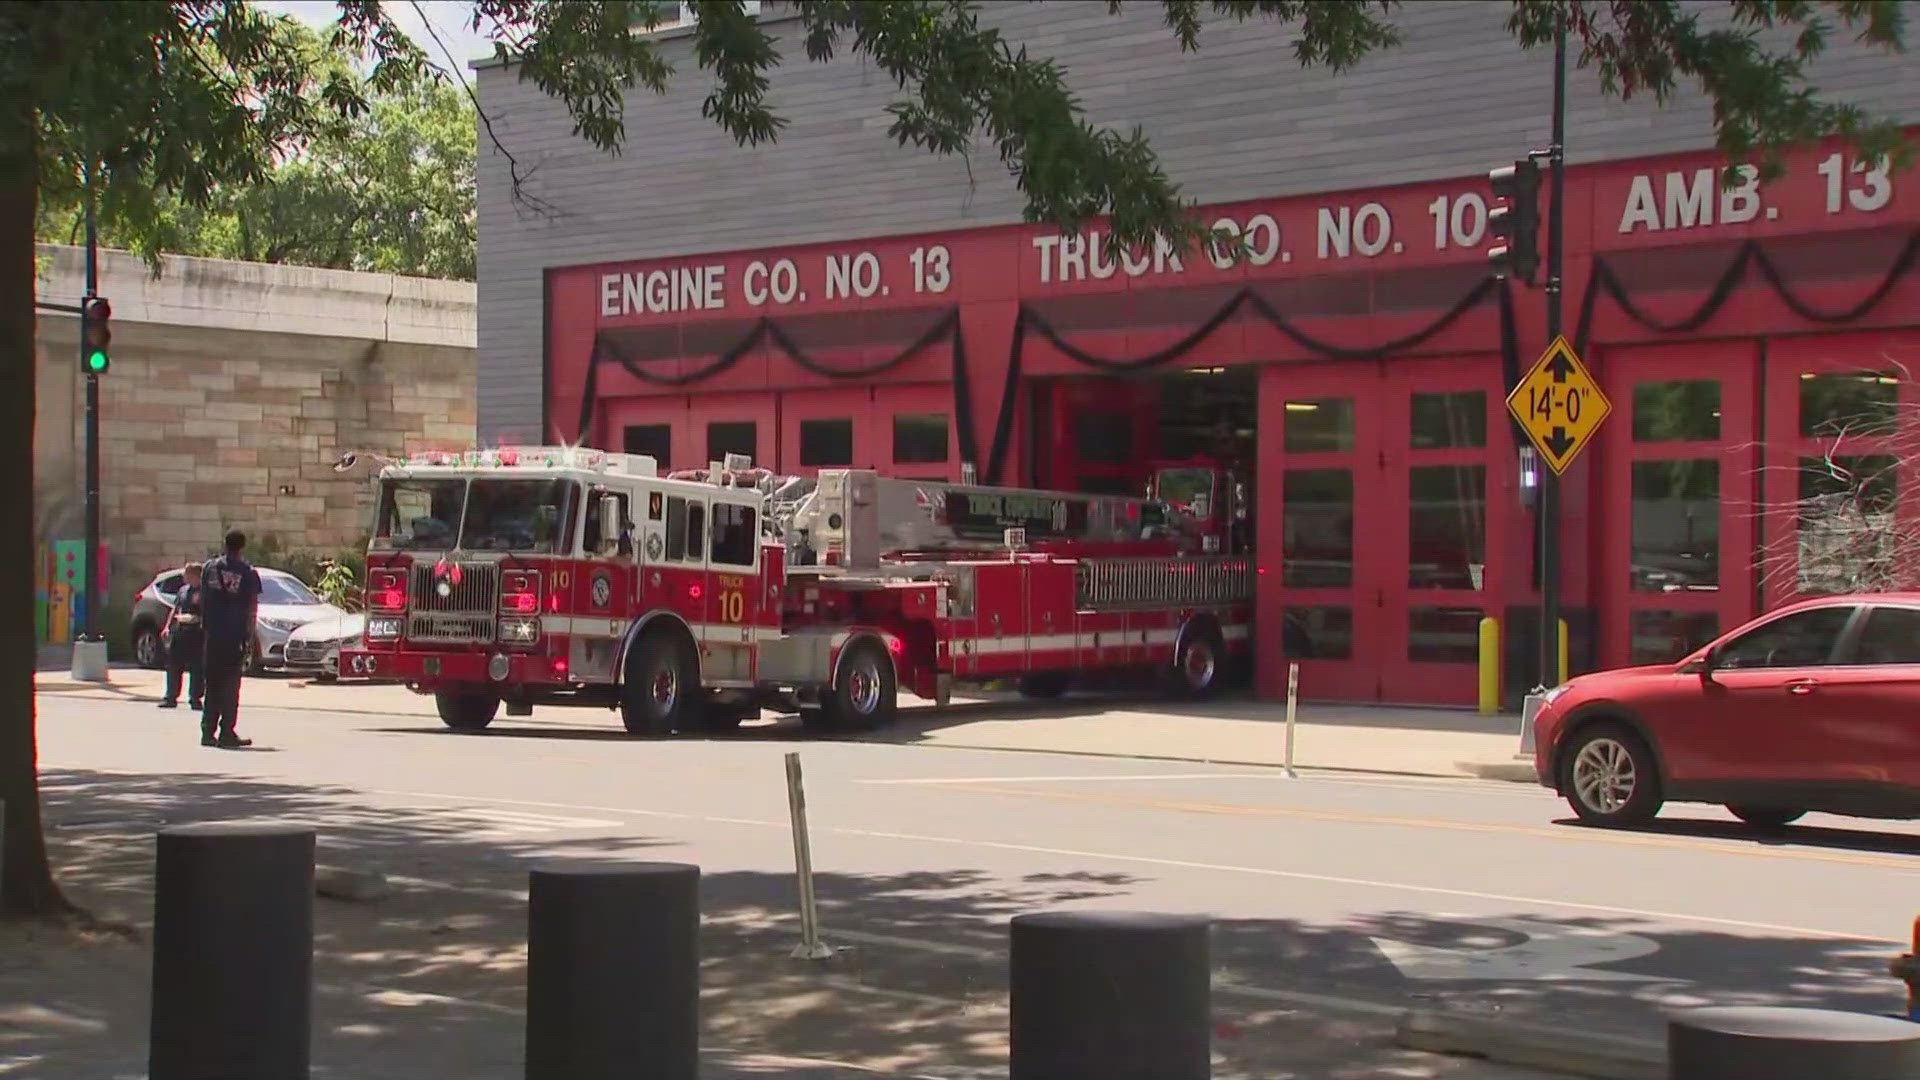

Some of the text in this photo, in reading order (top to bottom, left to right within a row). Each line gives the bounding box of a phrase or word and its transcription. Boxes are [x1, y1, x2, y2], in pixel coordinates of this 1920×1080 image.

[1618, 152, 1892, 233] AMB. 13
[1208, 213, 1291, 269] CO.
[1317, 202, 1403, 259] NO.
[1429, 191, 1487, 249] 10
[601, 245, 951, 317] ENGINE CO. NO. 13
[718, 574, 744, 587] TRUCK
[718, 590, 744, 623] 10
